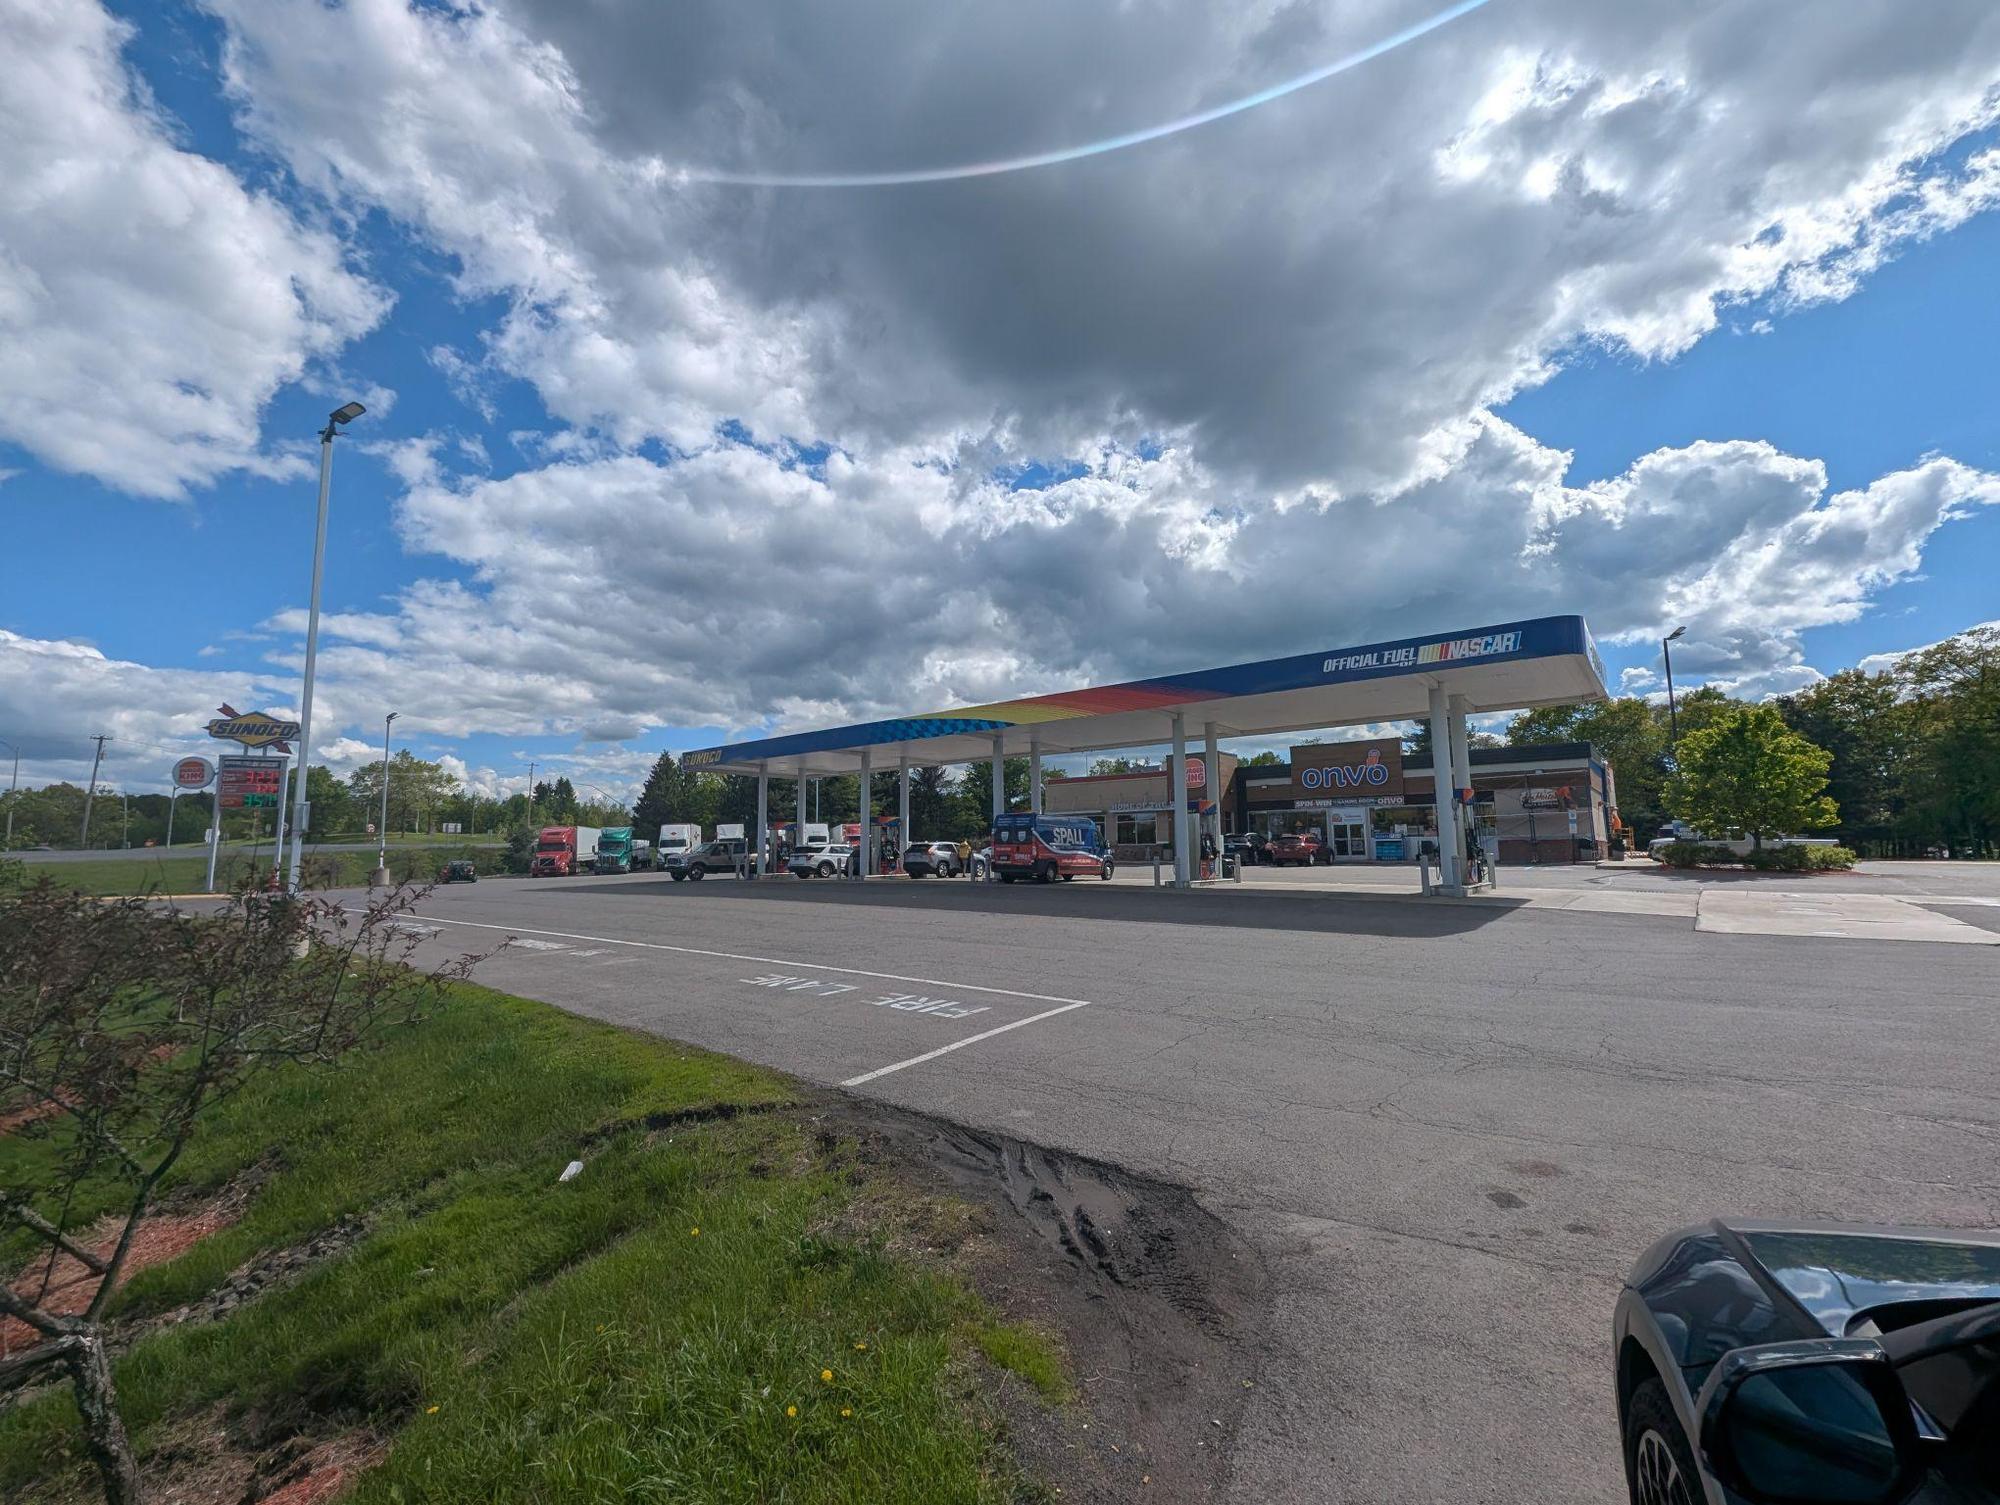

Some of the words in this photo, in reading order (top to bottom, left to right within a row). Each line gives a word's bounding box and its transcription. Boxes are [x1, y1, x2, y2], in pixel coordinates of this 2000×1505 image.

[1446, 632, 1517, 659] NASCAR
[1323, 654, 1380, 672] OFFICIAL
[1382, 647, 1416, 664] FUEL
[214, 721, 296, 737] SUNOCO
[684, 749, 722, 766] SUNOCO
[179, 772, 204, 780] KING
[1185, 772, 1204, 783] ING
[1302, 764, 1388, 789] onvo
[1377, 797, 1403, 805] onvo
[1053, 827, 1085, 845] SPALL
[738, 973, 859, 996] LANE
[860, 992, 991, 1019] FIRE
